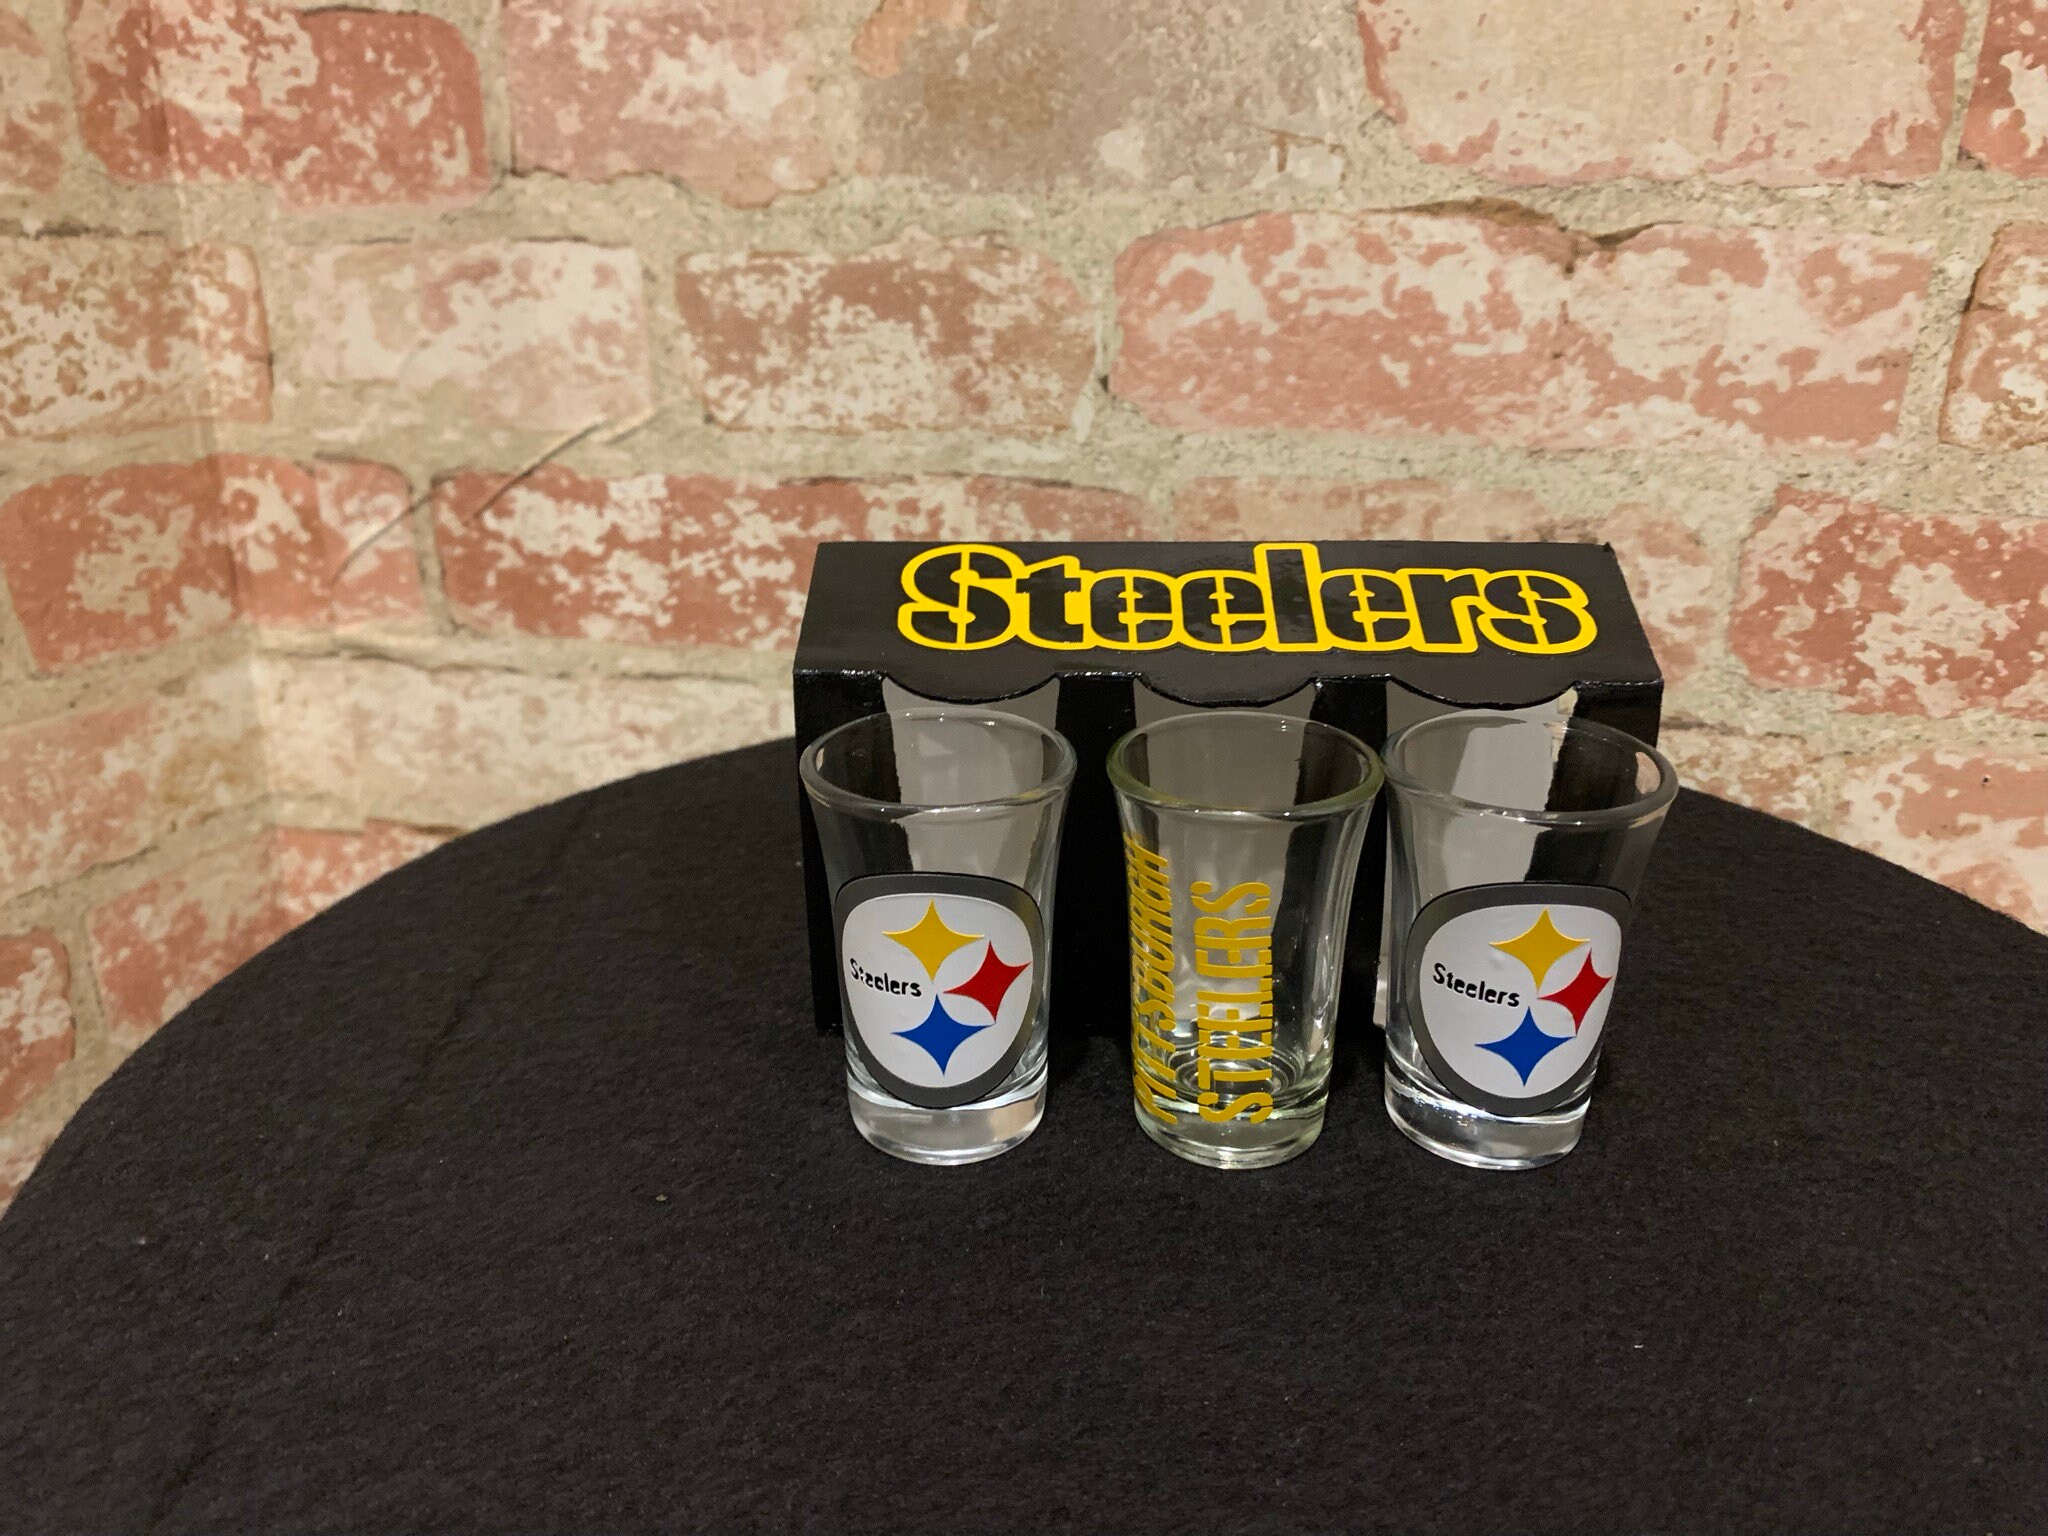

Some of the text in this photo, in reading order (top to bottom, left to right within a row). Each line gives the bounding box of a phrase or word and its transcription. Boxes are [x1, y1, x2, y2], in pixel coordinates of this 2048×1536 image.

[897, 542, 1598, 653] Steelers
[849, 957, 922, 998] Steelers
[1190, 881, 1273, 1124] STEELERS
[1432, 962, 1520, 1008] Steelers
